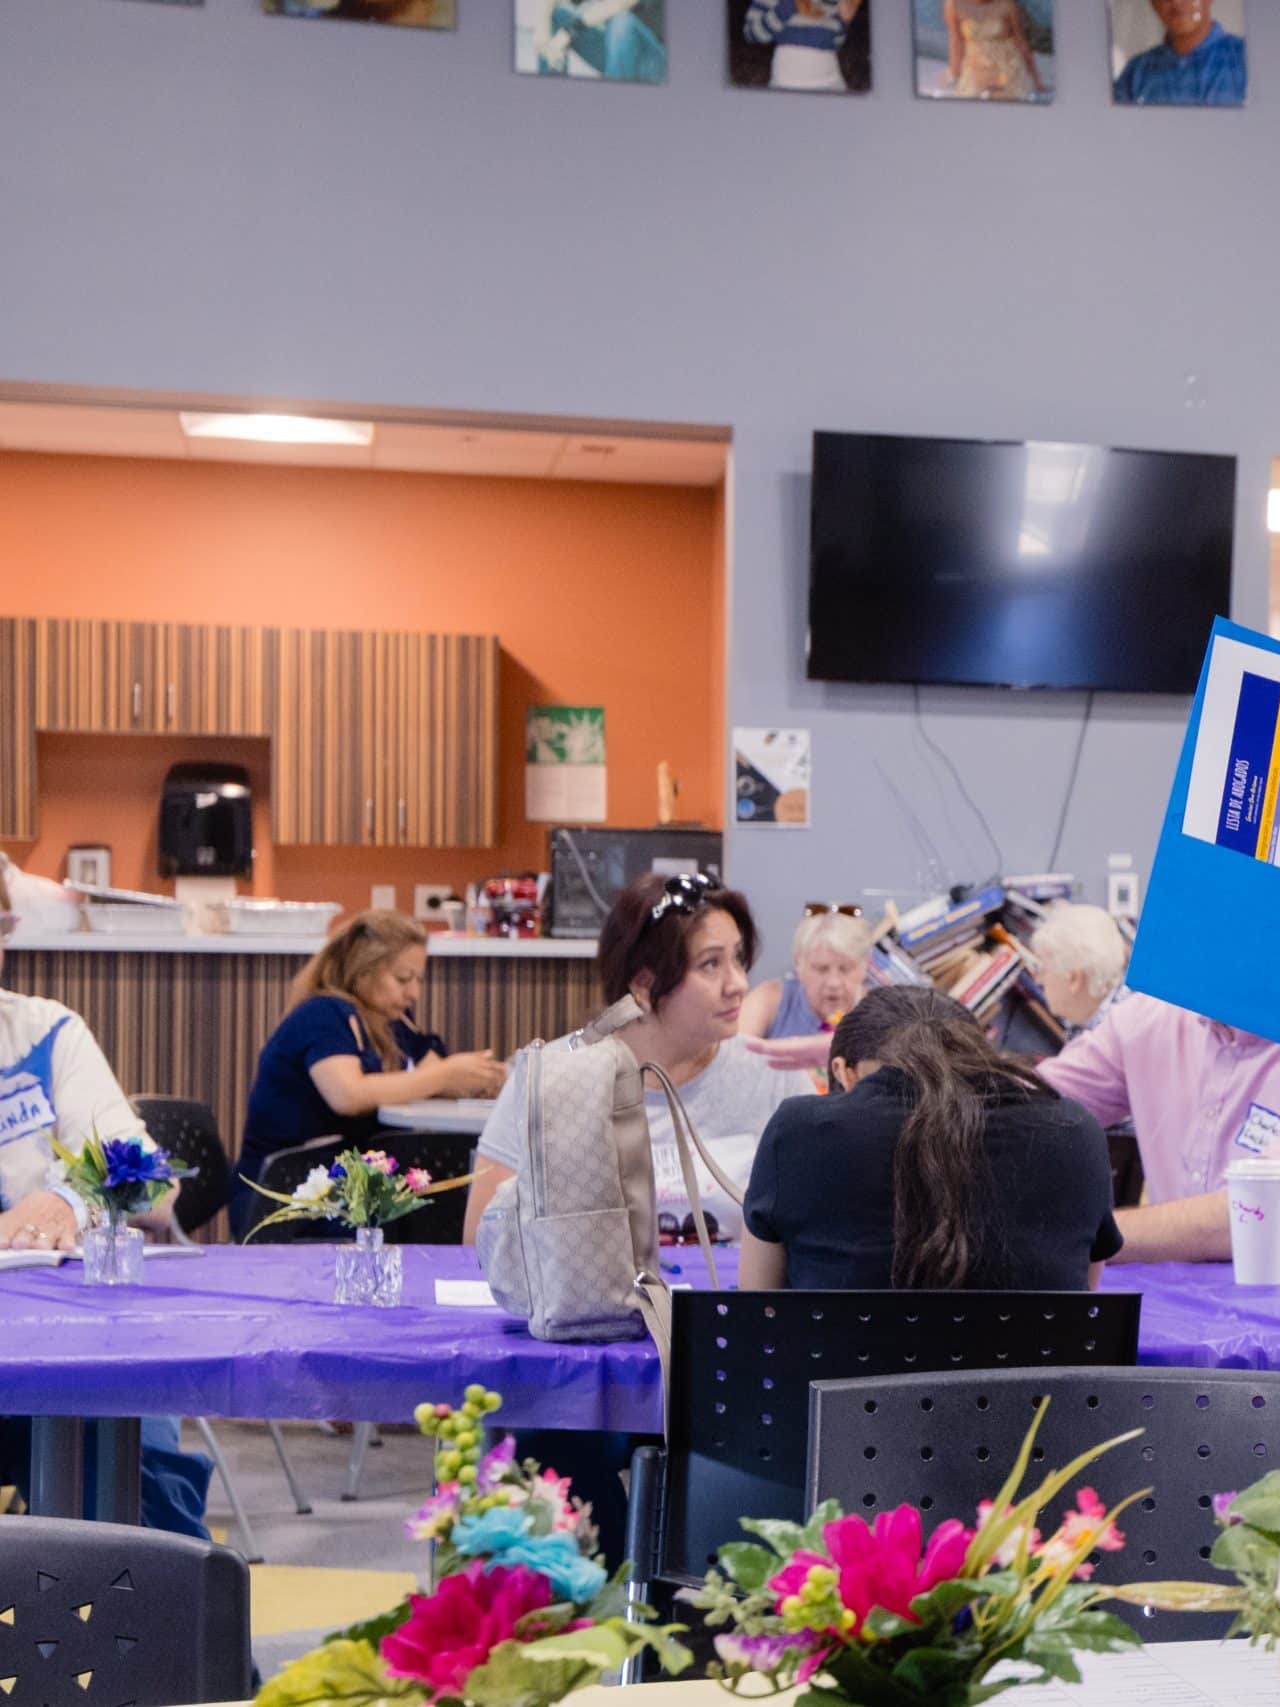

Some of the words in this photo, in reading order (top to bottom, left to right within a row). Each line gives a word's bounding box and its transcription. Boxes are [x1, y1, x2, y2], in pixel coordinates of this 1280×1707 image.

[1230, 758, 1250, 798] ABOGADOS
[1228, 796, 1243, 809] DE
[1225, 808, 1241, 831] LISTA
